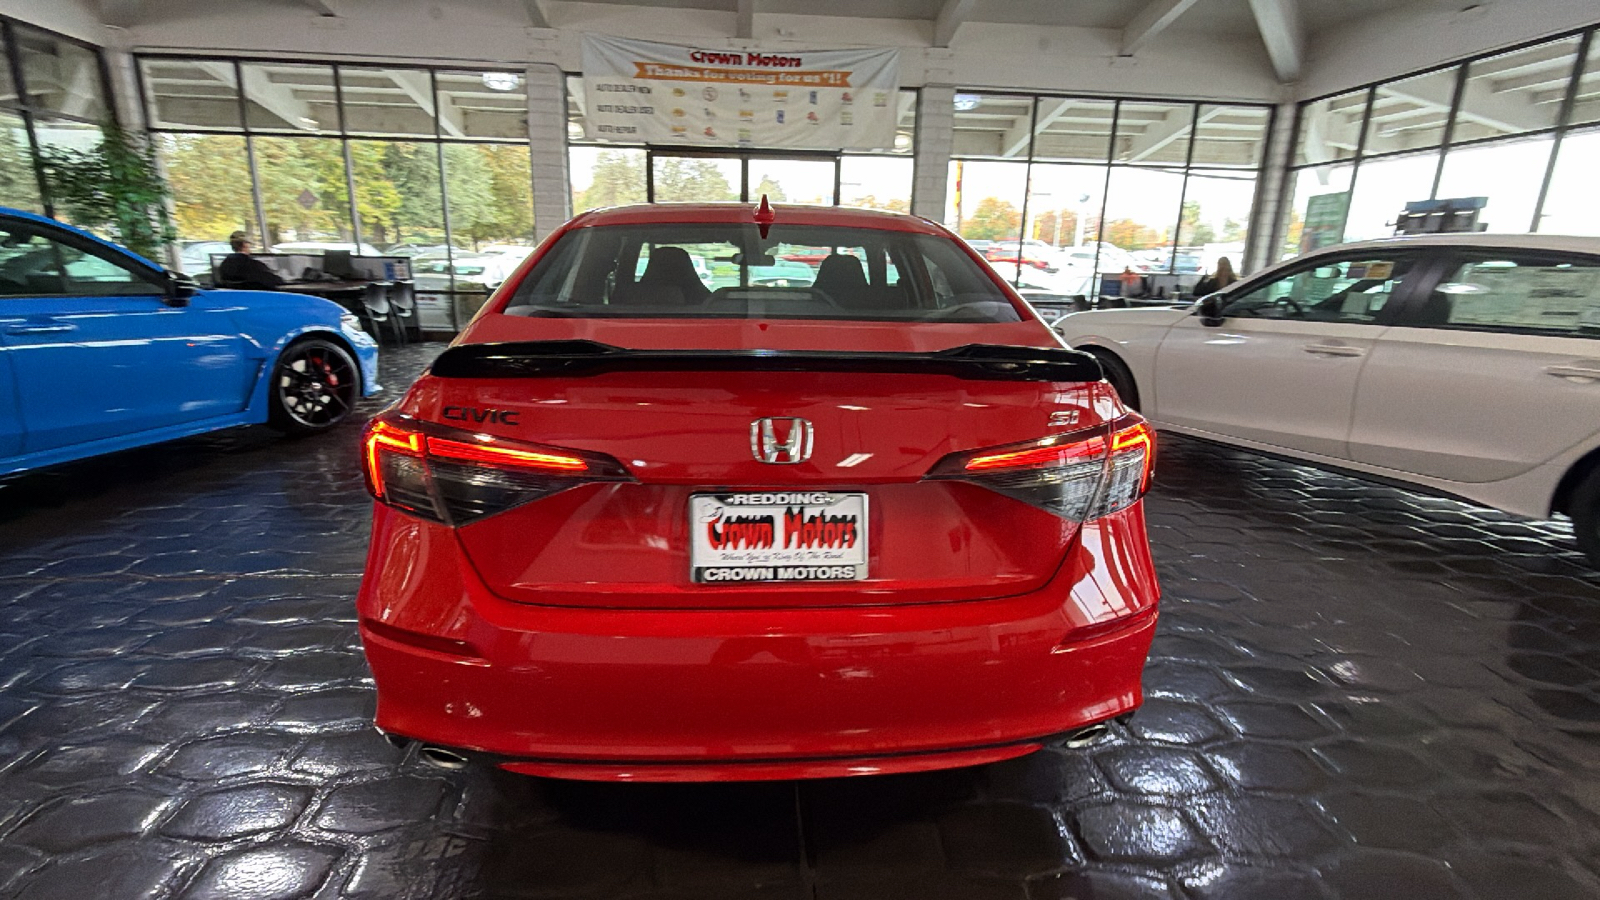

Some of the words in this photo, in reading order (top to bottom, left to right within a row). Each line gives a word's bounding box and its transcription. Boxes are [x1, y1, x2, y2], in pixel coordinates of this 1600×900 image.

[690, 51, 742, 65] Crown
[747, 53, 802, 67] Motors
[645, 64, 700, 77] Thanks
[779, 73, 801, 82] for
[443, 405, 520, 426] CIVIC
[733, 493, 826, 505] REDDING
[707, 514, 774, 550] Crown
[783, 506, 857, 550] Motors
[704, 567, 775, 581] CROWN
[777, 566, 856, 580] MOTORS
